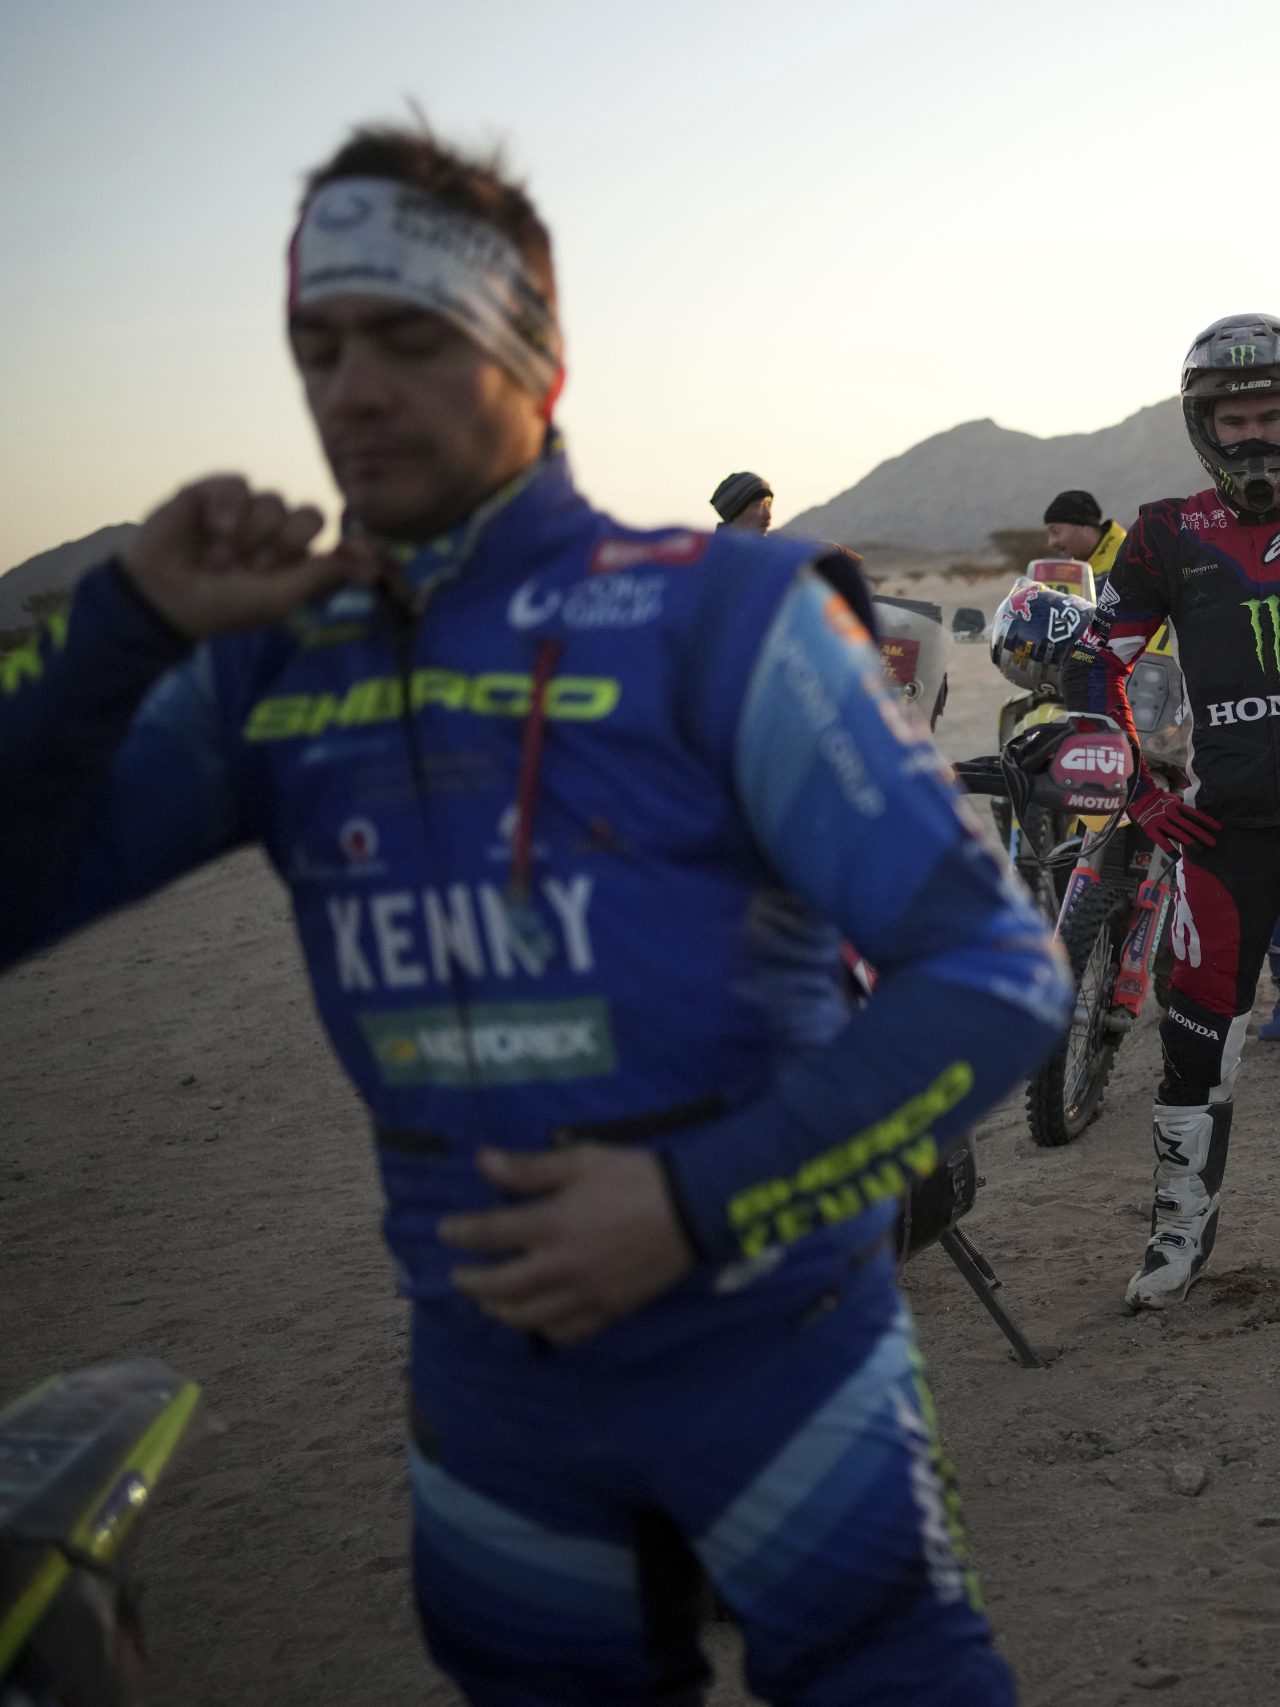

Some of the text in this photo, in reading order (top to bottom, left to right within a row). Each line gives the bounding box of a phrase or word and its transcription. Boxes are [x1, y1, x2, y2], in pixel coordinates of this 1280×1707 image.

[1060, 745, 1125, 776] GIVI
[1067, 794, 1121, 809] MOTUL
[325, 873, 594, 992] KENNY
[1168, 1005, 1221, 1042] HONDA
